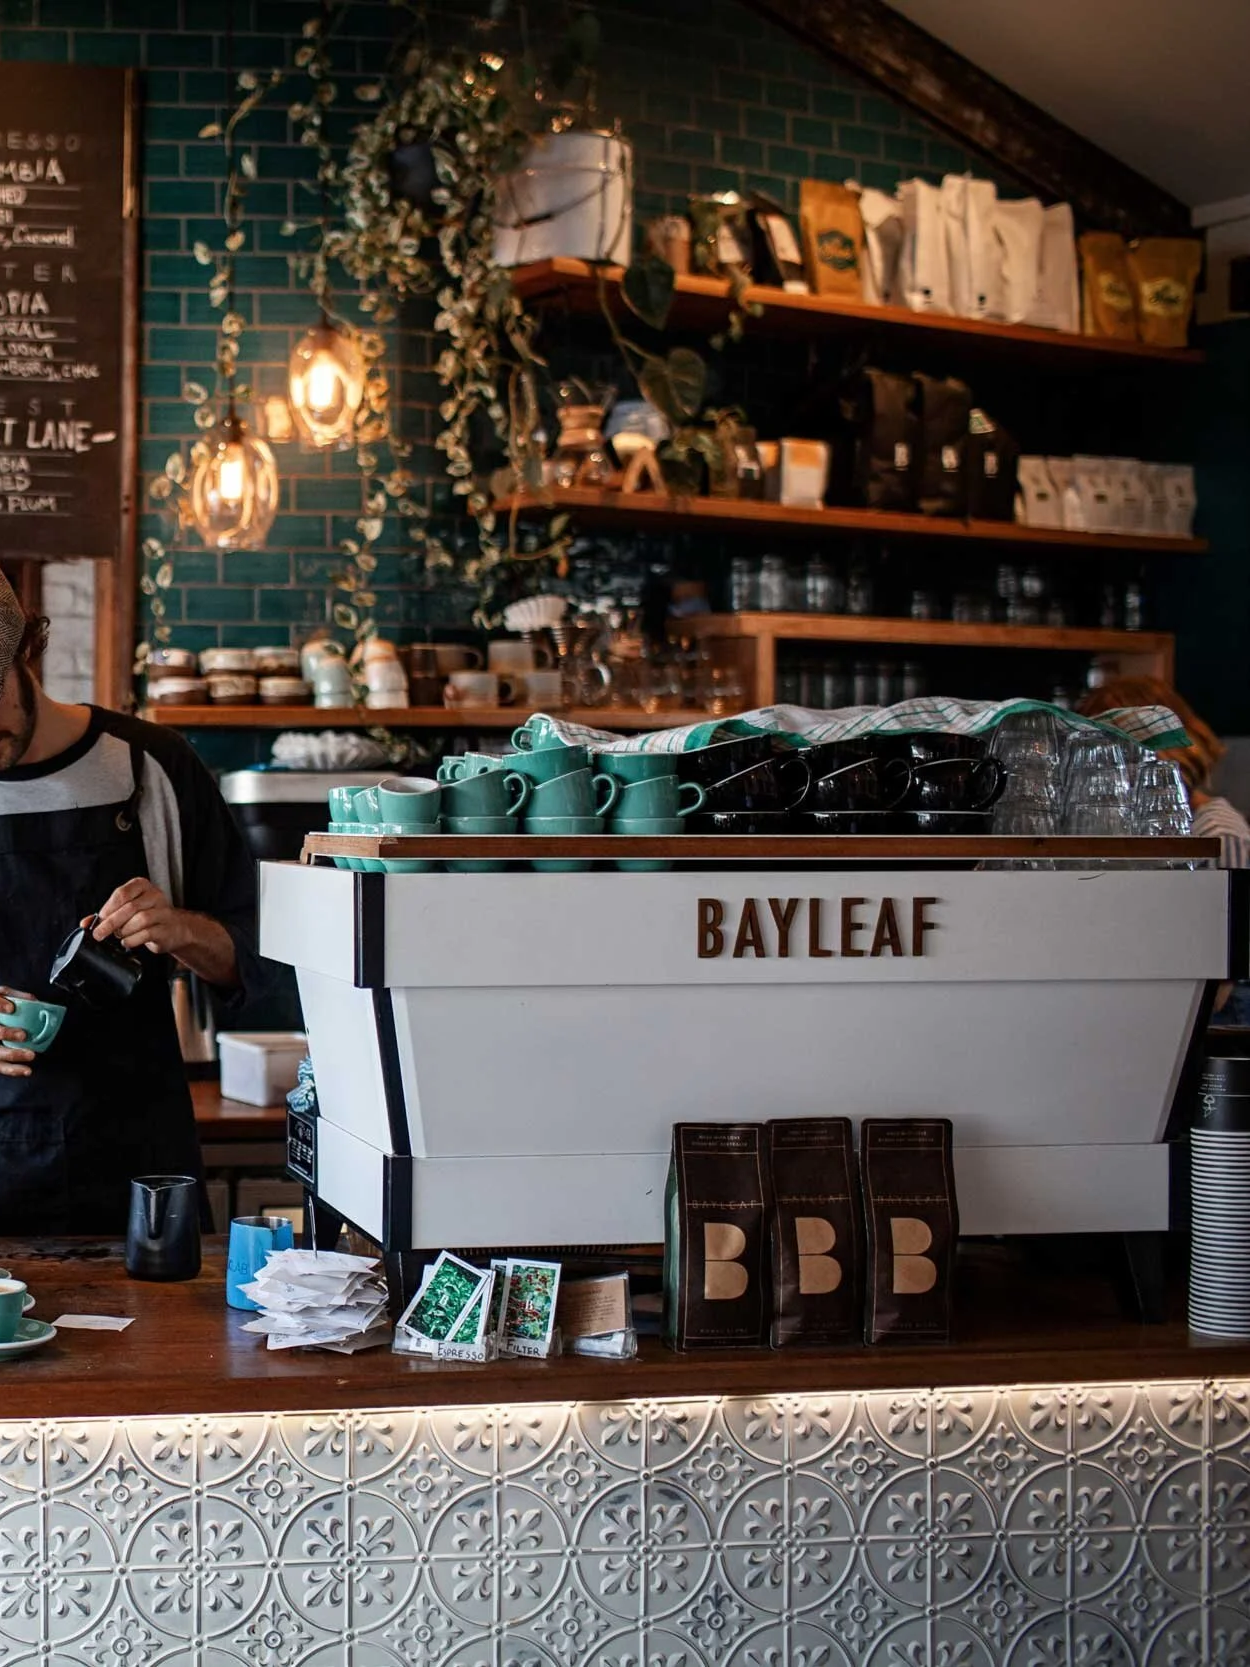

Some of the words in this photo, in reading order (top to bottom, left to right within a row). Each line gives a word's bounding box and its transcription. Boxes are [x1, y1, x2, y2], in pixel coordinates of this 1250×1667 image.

[26, 418, 94, 454] LANE
[696, 896, 940, 959] BAYLEAF
[704, 1222, 749, 1300] B
[795, 1217, 842, 1294] B
[890, 1217, 937, 1294] B
[506, 1338, 540, 1356] FILTER
